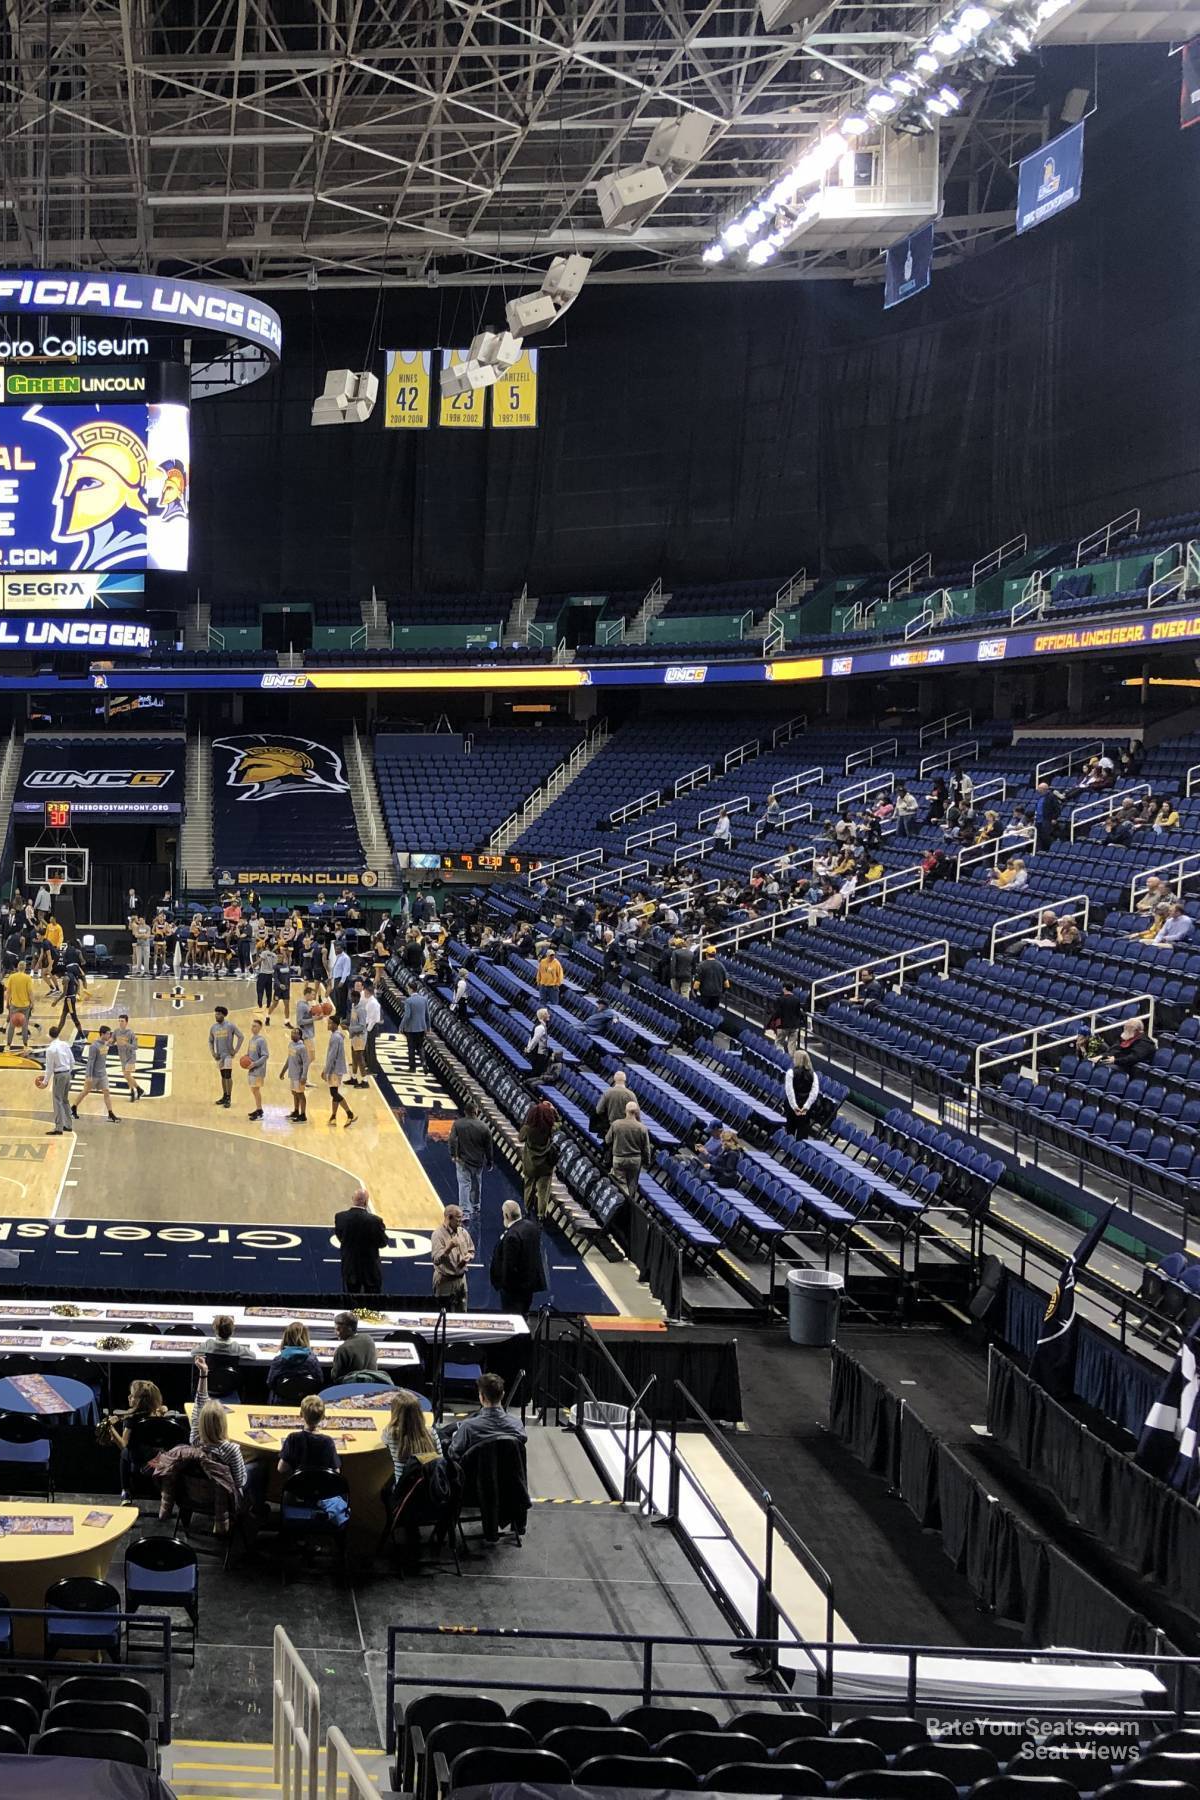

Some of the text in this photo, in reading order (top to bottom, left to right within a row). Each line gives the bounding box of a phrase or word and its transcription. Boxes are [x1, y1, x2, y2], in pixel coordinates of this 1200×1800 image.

[152, 288, 243, 326] UNCG
[43, 336, 149, 357] Coliseum
[7, 375, 145, 394] GREEN LINCOLN
[399, 374, 418, 383] HINES
[396, 387, 419, 411] 42
[452, 388, 474, 410] 23
[509, 386, 520, 410] 5
[25, 622, 106, 646] UNCG
[109, 624, 151, 649] GEAR
[1035, 633, 1079, 652] OFFICIAL
[1081, 629, 1110, 647] UNCG
[1111, 625, 1146, 644] GEAR.
[1152, 620, 1186, 639] OVER
[262, 674, 307, 687] UNCG
[666, 667, 706, 683] UNCG
[27, 771, 169, 787] UNCG
[47, 803, 69, 812] 27:30
[50, 812, 66, 825] 30
[478, 856, 502, 866] 27:30
[238, 873, 359, 884] SPARTAN CLUB
